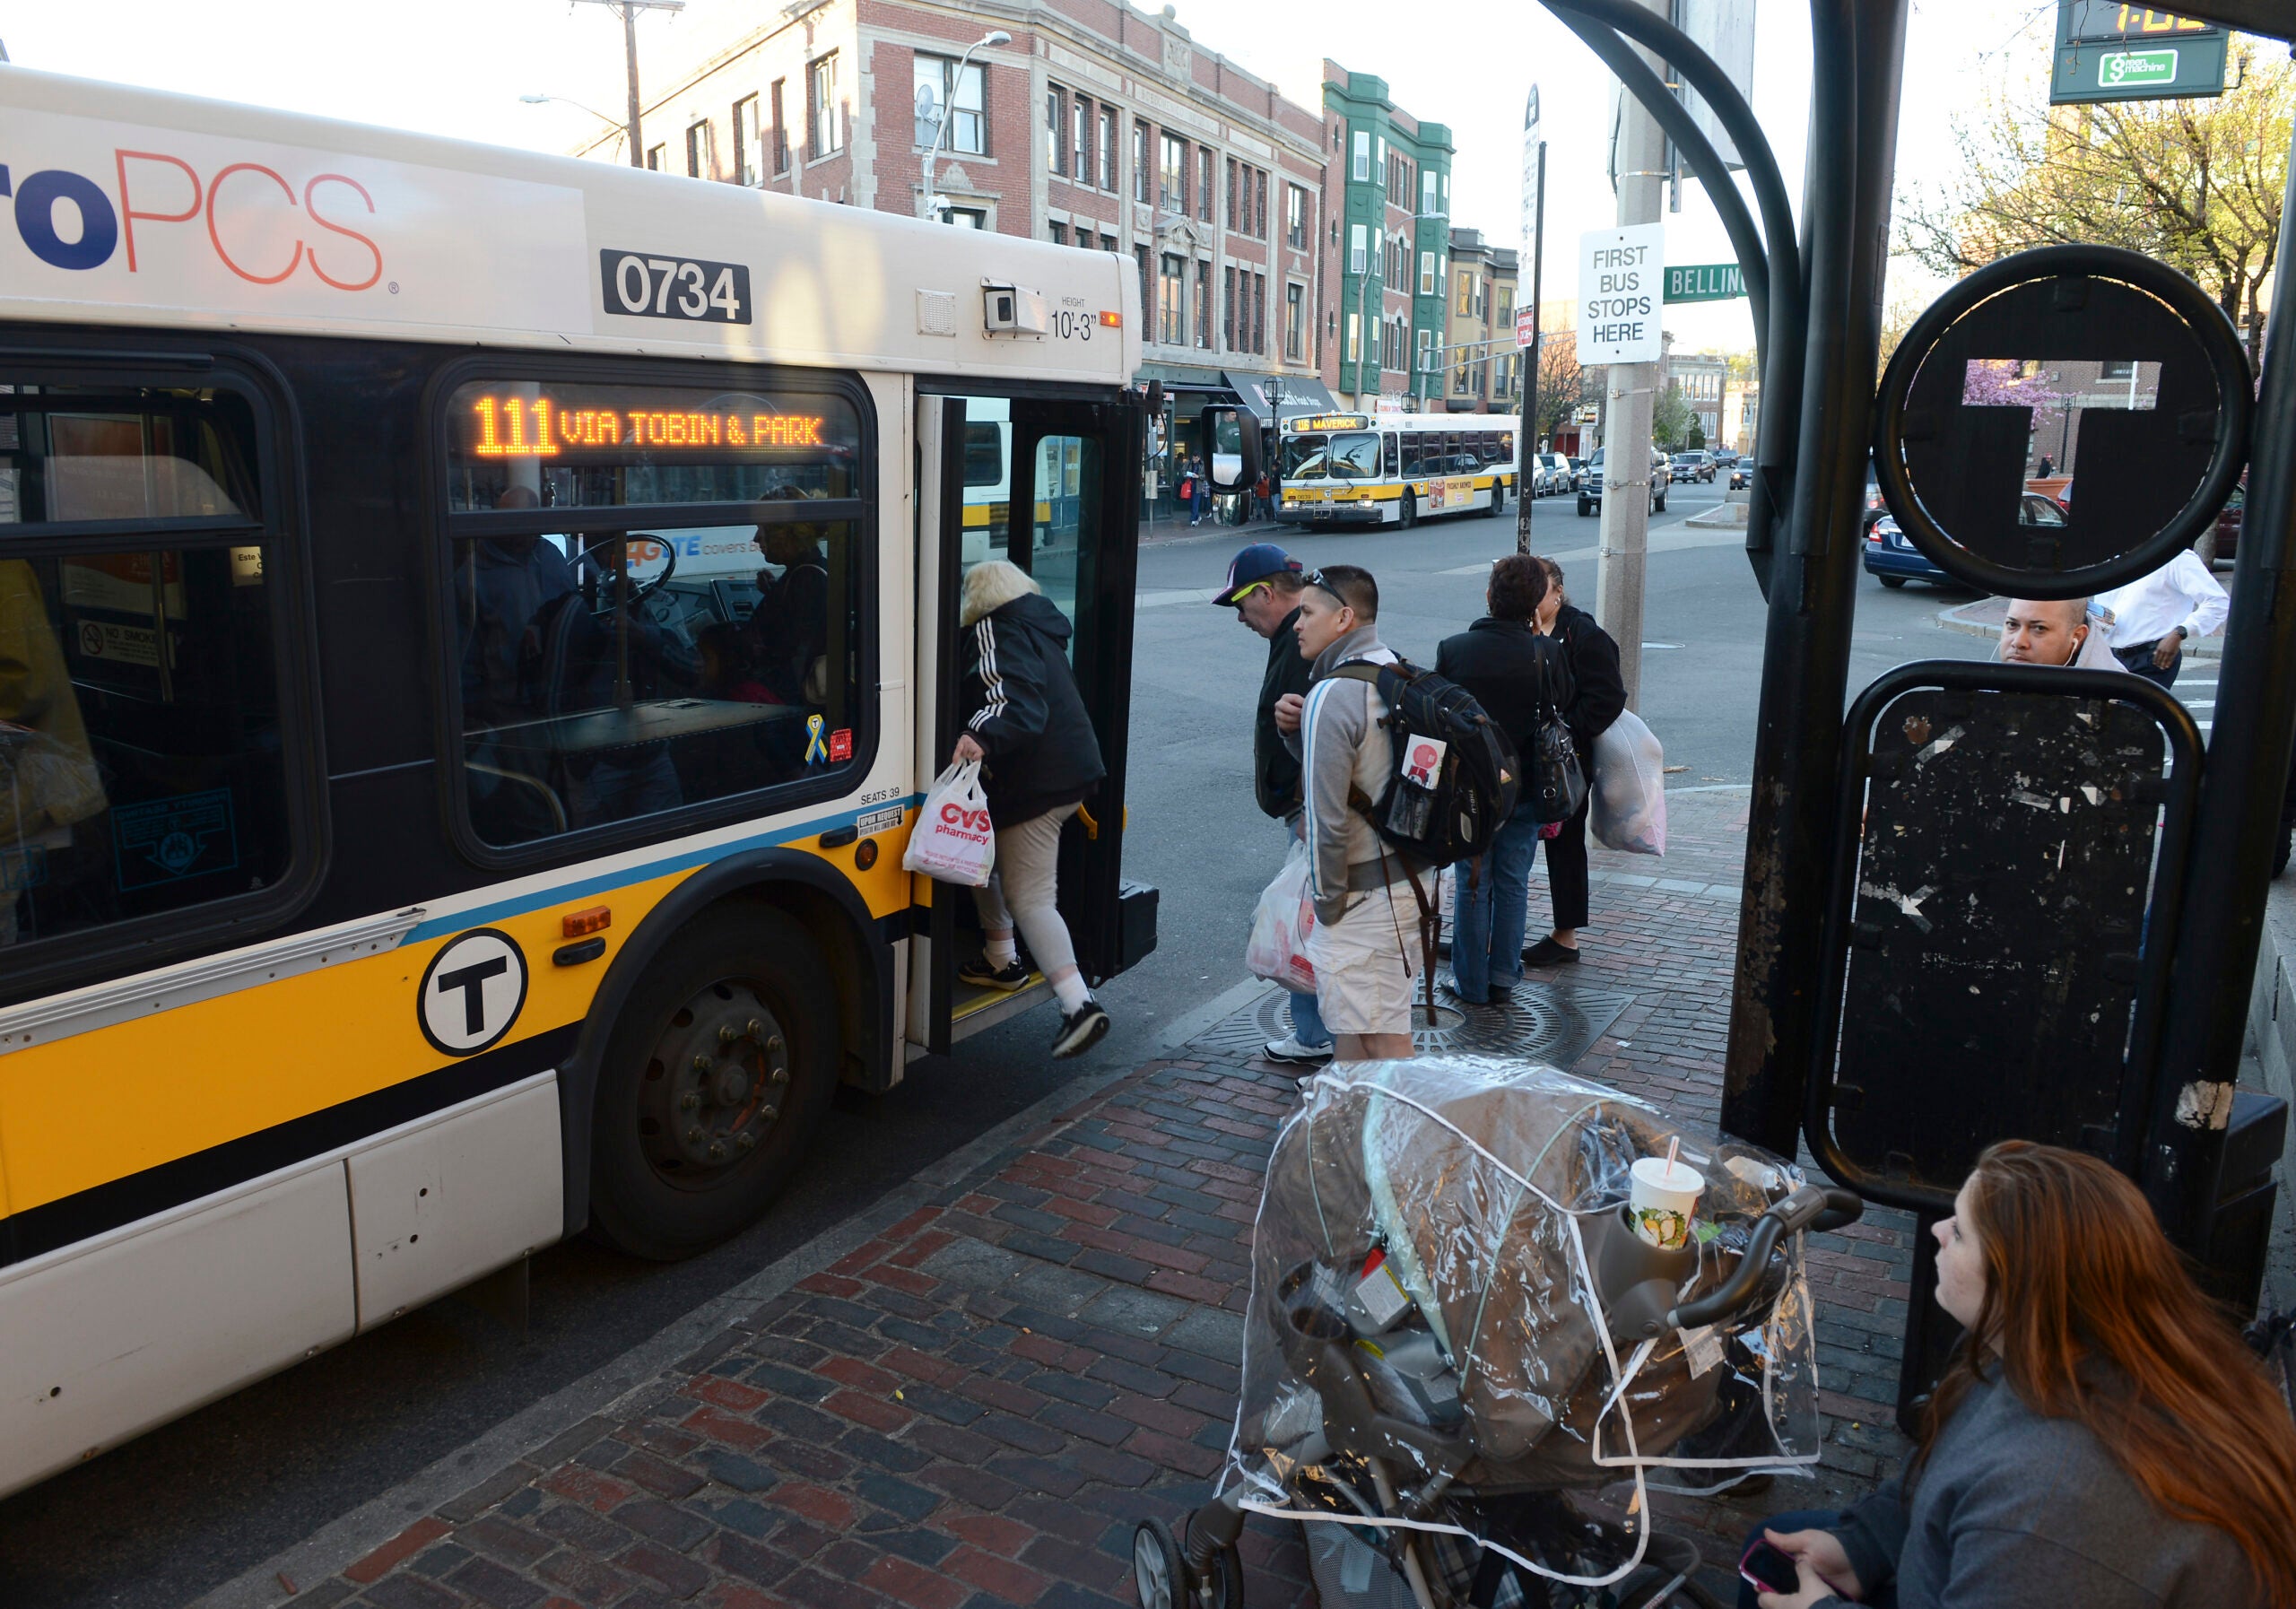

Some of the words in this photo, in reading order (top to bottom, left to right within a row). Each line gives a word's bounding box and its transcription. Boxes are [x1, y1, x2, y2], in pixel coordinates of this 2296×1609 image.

[2125, 63, 2166, 74] machine
[1593, 245, 1648, 269] FIRST
[615, 255, 740, 321] 0734
[1600, 272, 1639, 293] BUS
[1061, 296, 1086, 308] HEIGHT
[1587, 296, 1651, 319] STOPS
[1593, 321, 1644, 344] HERE
[474, 396, 560, 456] 111
[560, 410, 619, 445] VIA
[628, 412, 718, 445] TOBIN
[726, 415, 746, 445] &
[753, 415, 822, 446] PARK
[1297, 419, 1310, 431] 116
[1312, 417, 1357, 430] MAVERICK
[238, 553, 256, 561] Este
[702, 541, 746, 556] covers
[105, 626, 119, 639] NO
[861, 791, 887, 805] SEATS
[889, 787, 900, 798] 39
[860, 814, 876, 827] UPON
[877, 808, 901, 822] REQUEST
[940, 803, 991, 832] CVS
[935, 823, 989, 846] pharmacy
[437, 954, 508, 1037] T
